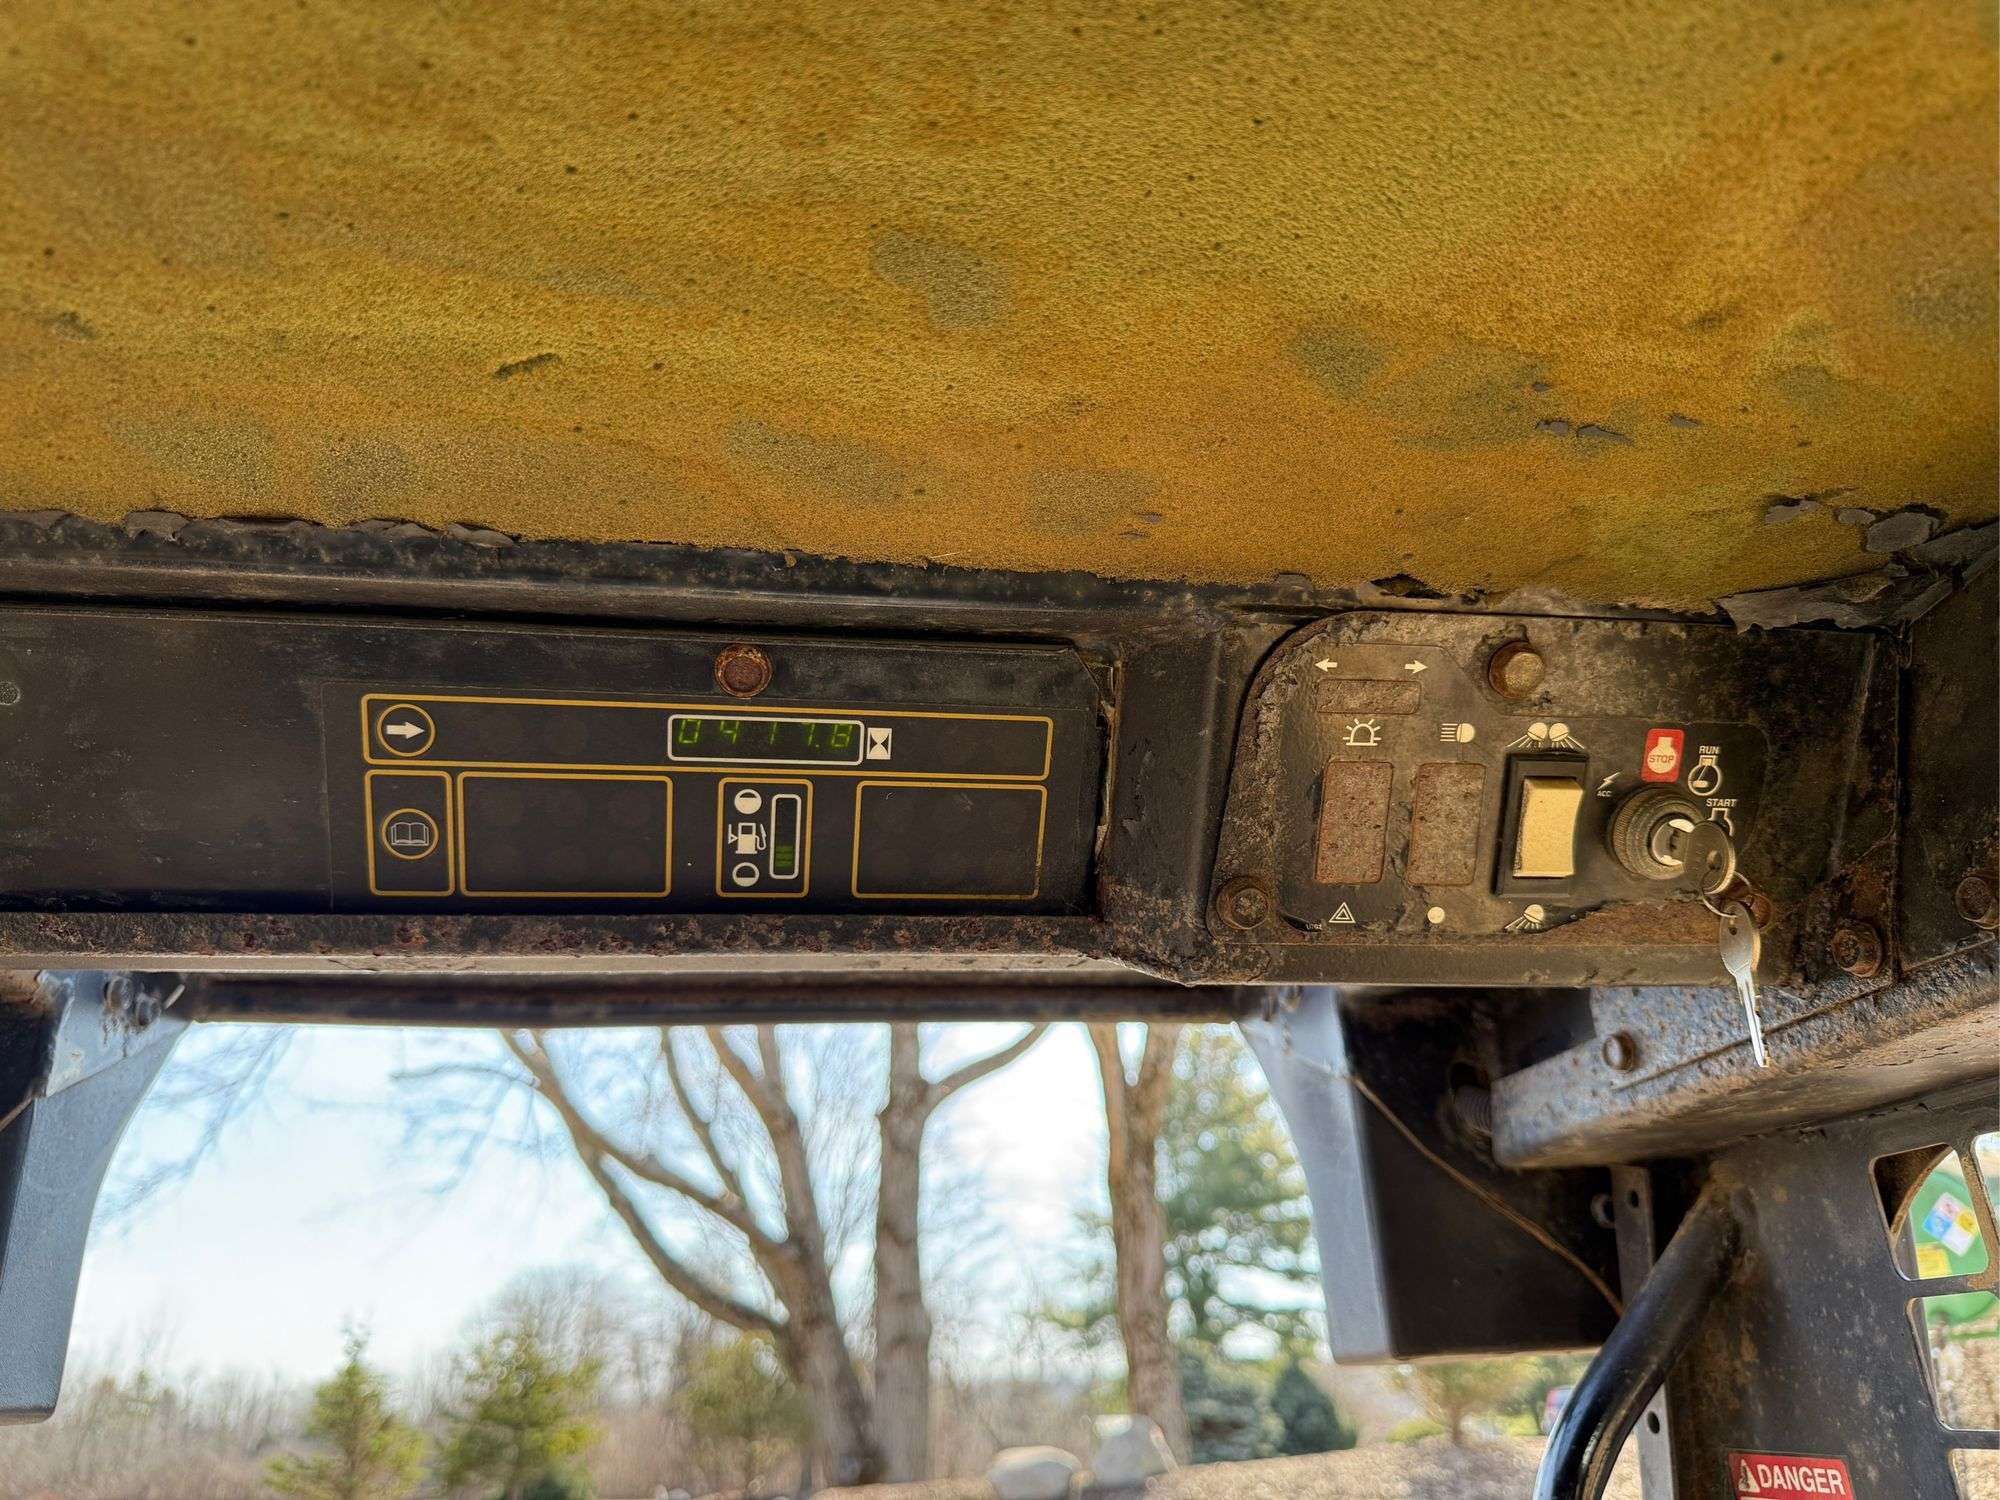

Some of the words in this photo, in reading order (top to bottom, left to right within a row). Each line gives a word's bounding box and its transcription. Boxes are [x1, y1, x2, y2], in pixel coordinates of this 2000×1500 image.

[1699, 746, 1719, 754] RUN
[1648, 755, 1674, 763] STOP
[1706, 799, 1737, 807] START
[1757, 1464, 1845, 1495] DANGER
